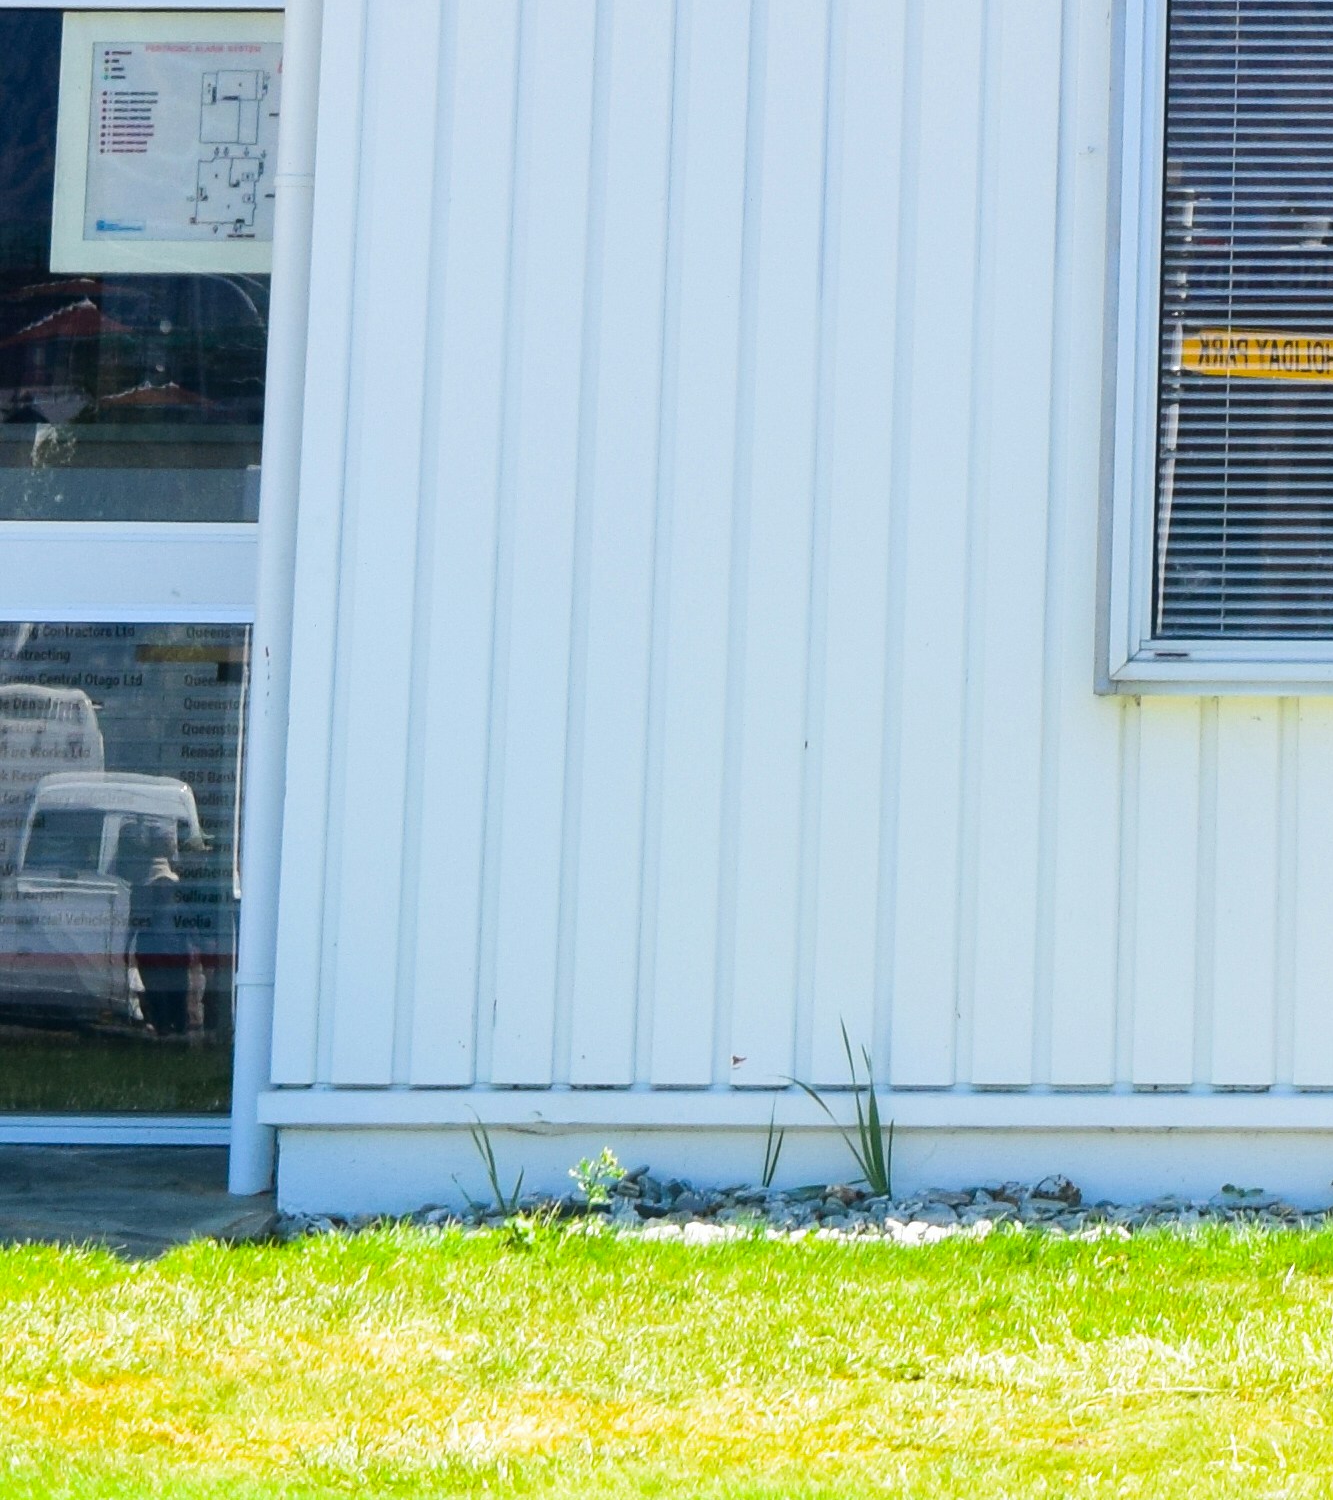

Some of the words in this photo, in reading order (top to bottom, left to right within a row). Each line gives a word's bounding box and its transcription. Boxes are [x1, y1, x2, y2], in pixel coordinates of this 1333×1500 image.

[43, 624, 112, 638] Contractors
[114, 623, 136, 638] Ltd
[38, 672, 82, 686] Central
[84, 673, 120, 690] Otago
[123, 673, 143, 687] Ltd
